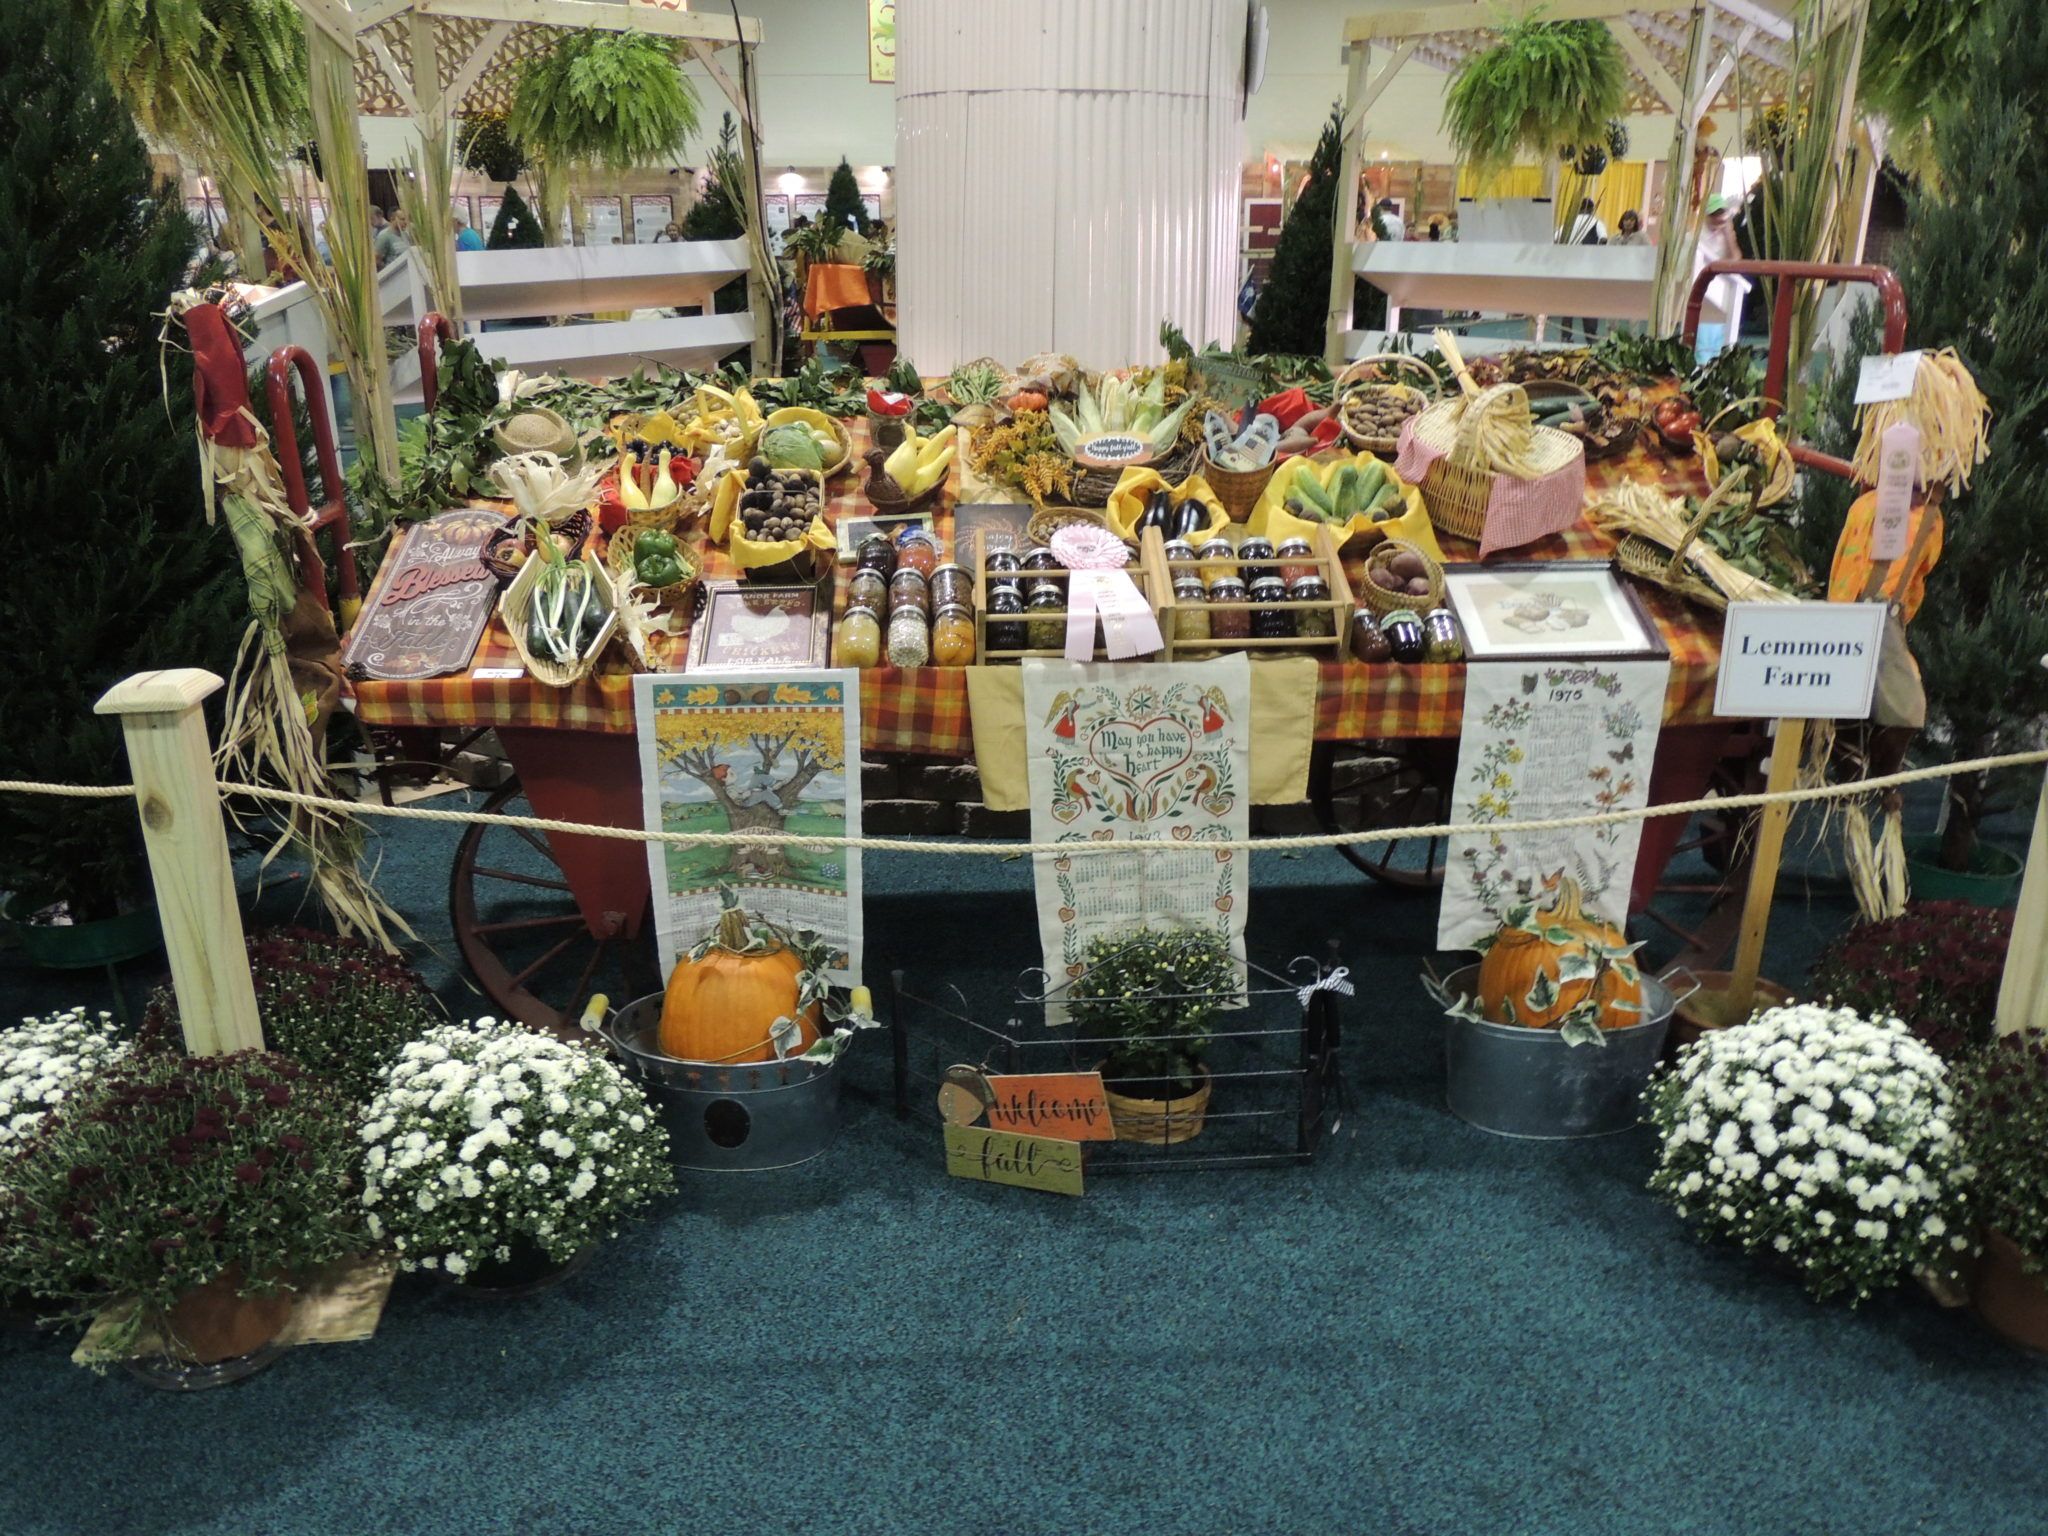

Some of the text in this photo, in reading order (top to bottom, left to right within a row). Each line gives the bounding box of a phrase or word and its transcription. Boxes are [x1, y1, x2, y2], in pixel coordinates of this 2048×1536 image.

[429, 541, 482, 562] Alway
[381, 565, 490, 606] Blessed
[407, 614, 447, 626] in the
[1741, 635, 1864, 657] Lemmons
[1763, 666, 1831, 686] Farm
[1101, 728, 1187, 750] May you have
[1136, 744, 1183, 759] a happy
[994, 1089, 1104, 1127] welcome
[982, 1136, 1044, 1179] fall
